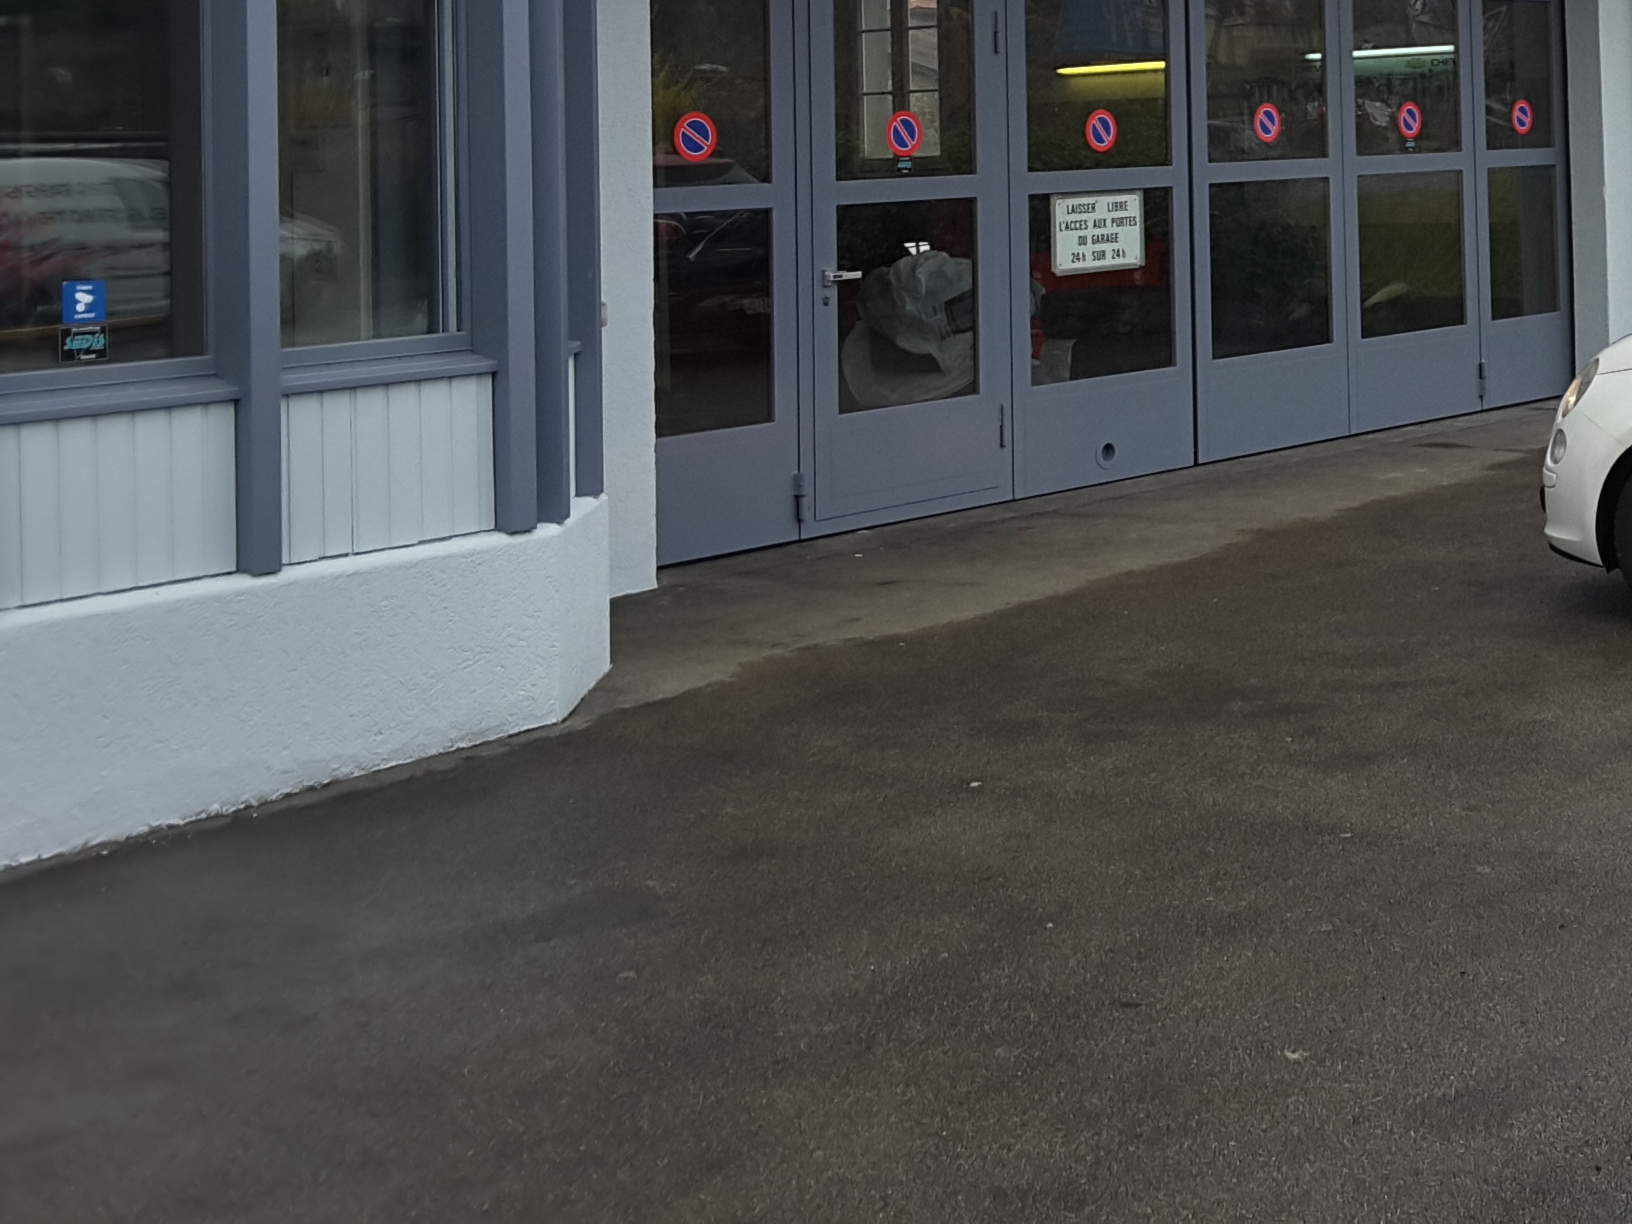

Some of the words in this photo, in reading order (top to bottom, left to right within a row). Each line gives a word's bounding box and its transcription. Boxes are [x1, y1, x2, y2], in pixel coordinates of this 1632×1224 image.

[1107, 200, 1129, 213] LIBRE
[1058, 220, 1089, 232] L'ACCES
[1092, 218, 1108, 229] AUX
[1111, 216, 1138, 228] PORTES
[1077, 235, 1088, 246] DU
[1091, 232, 1119, 245] GARAGE
[1071, 251, 1086, 263] 24h
[1092, 250, 1106, 261] SUR
[1111, 248, 1126, 260] 24h
